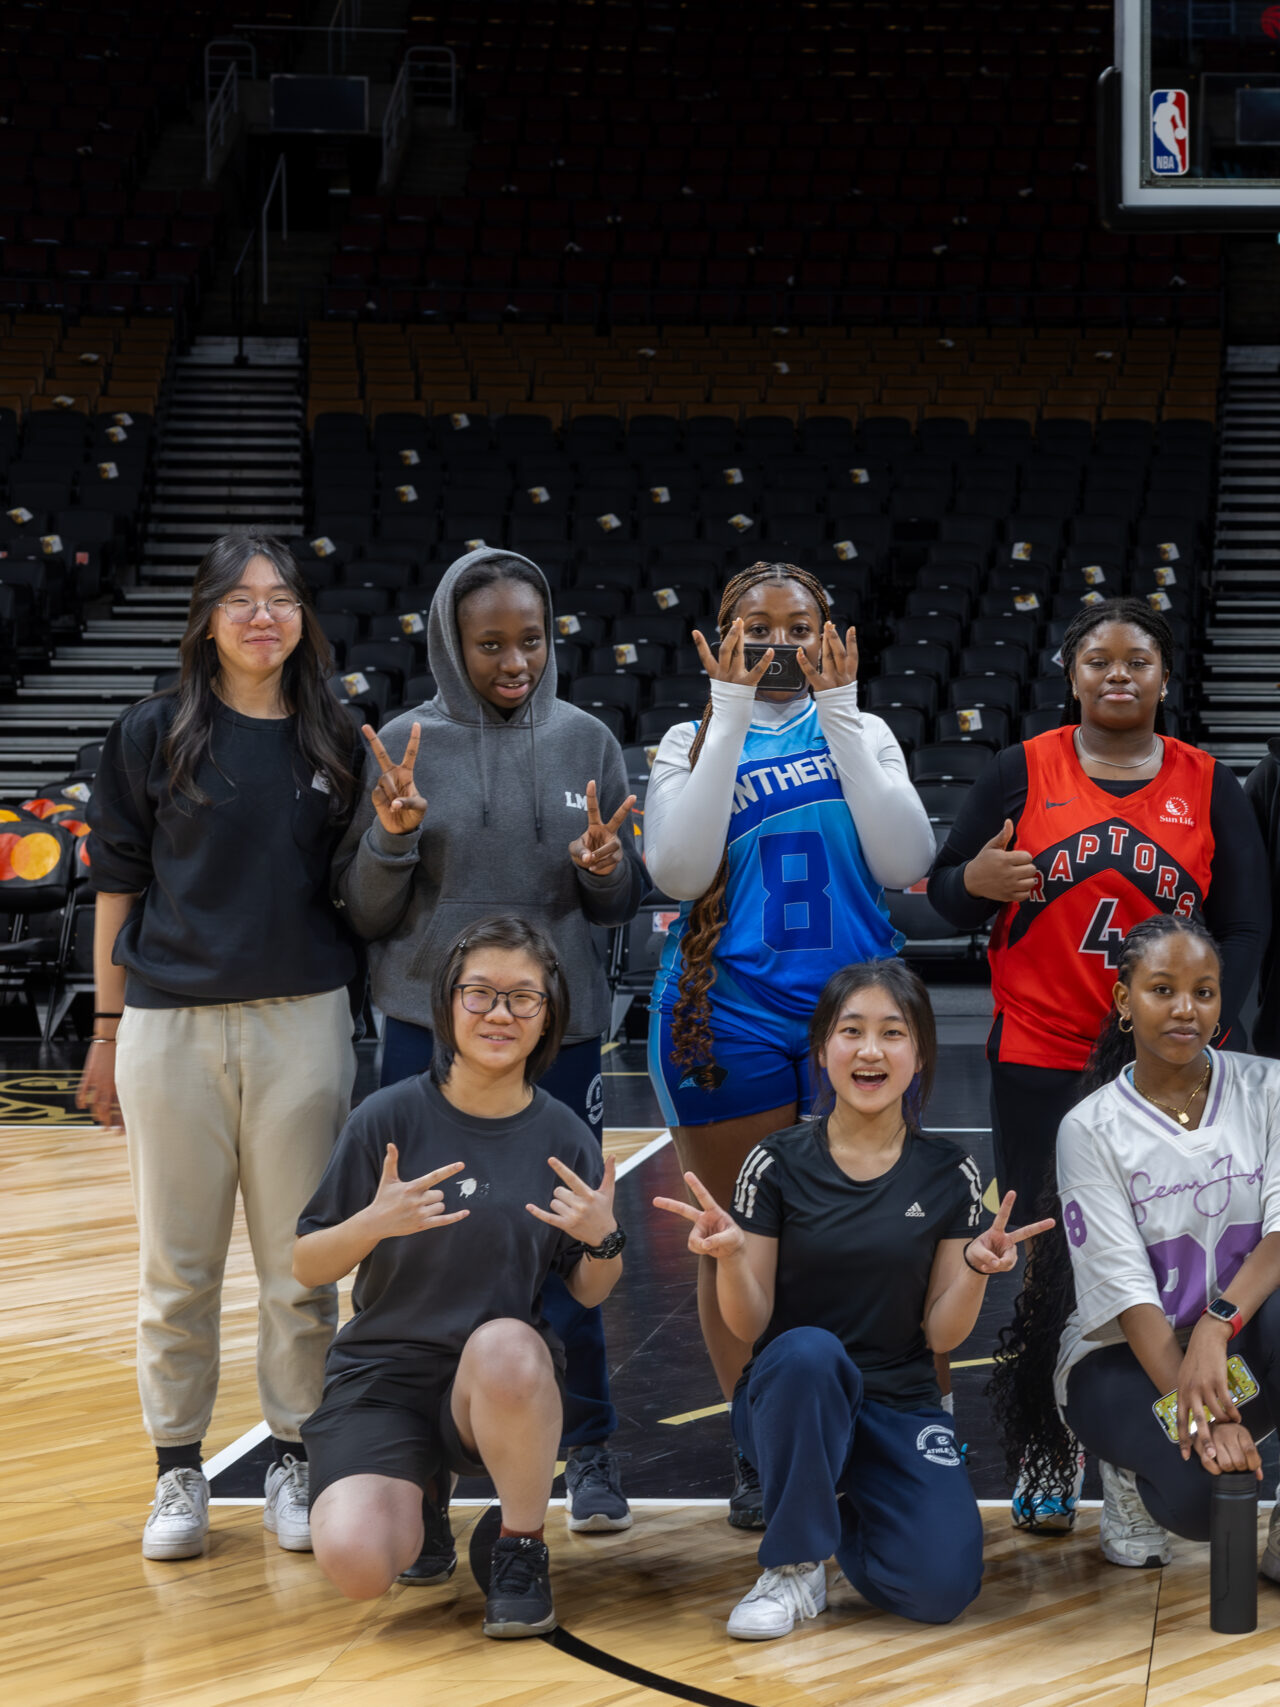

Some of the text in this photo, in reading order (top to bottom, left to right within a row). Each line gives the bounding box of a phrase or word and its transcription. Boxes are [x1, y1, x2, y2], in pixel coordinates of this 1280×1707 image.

[1156, 156, 1175, 169] NBA
[731, 753, 841, 815] NTHER
[1160, 815, 1195, 827] Sun Life
[758, 830, 833, 954] 8
[1078, 897, 1125, 970] 4
[1193, 1154, 1264, 1218] Jo
[1064, 1200, 1087, 1249] 8
